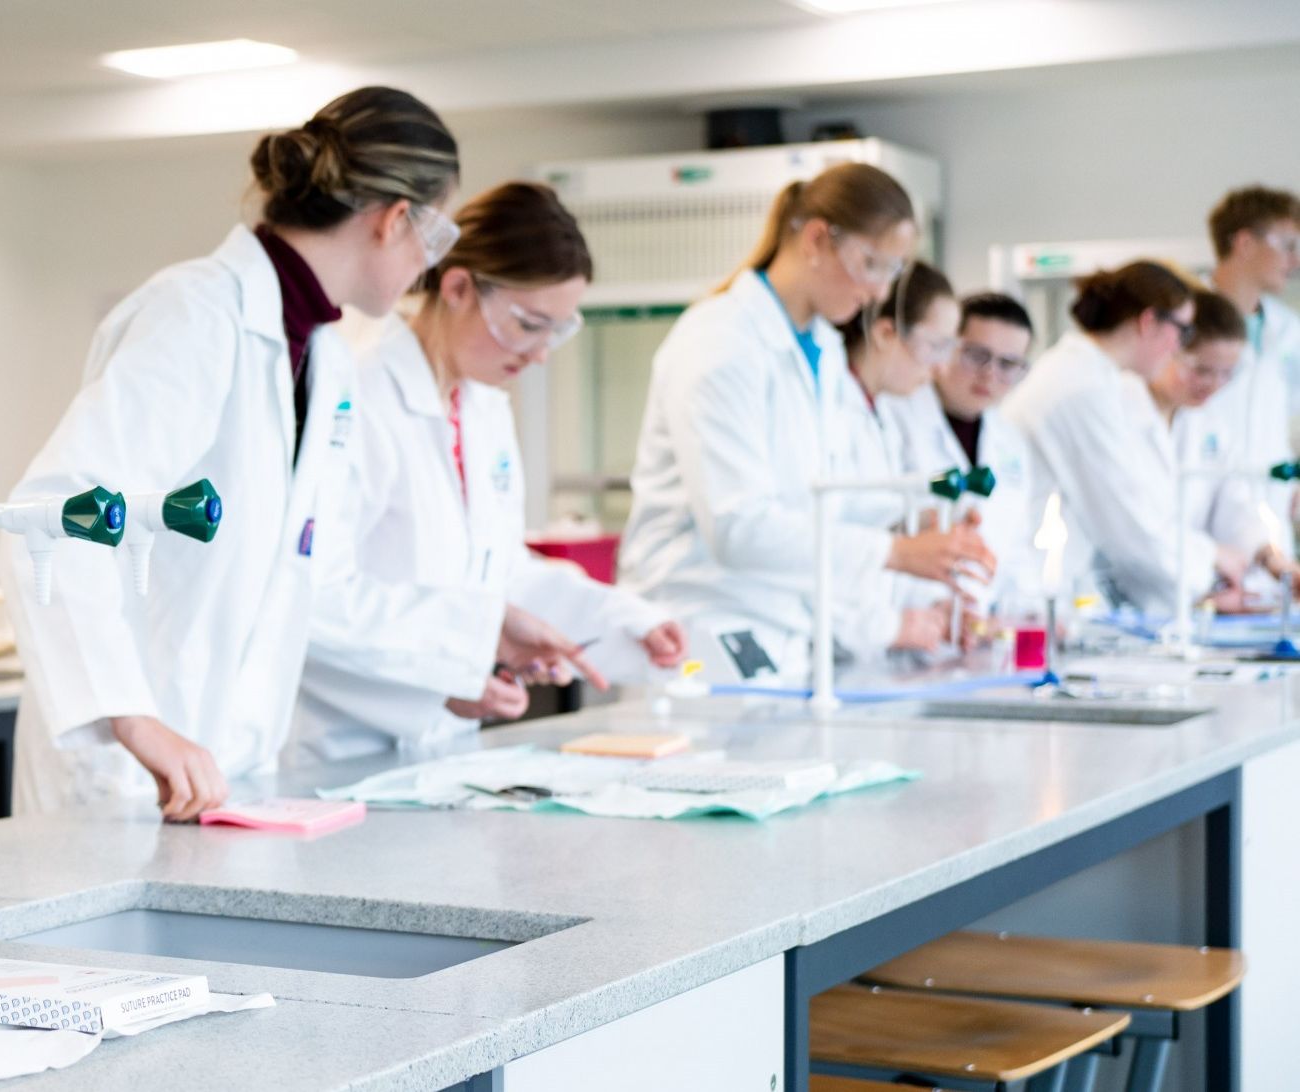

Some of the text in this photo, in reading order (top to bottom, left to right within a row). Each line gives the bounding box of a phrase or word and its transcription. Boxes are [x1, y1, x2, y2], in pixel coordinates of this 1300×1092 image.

[121, 998, 146, 1013] SUTURE
[147, 990, 178, 1007] PRACTICE
[178, 987, 191, 999] PAD
